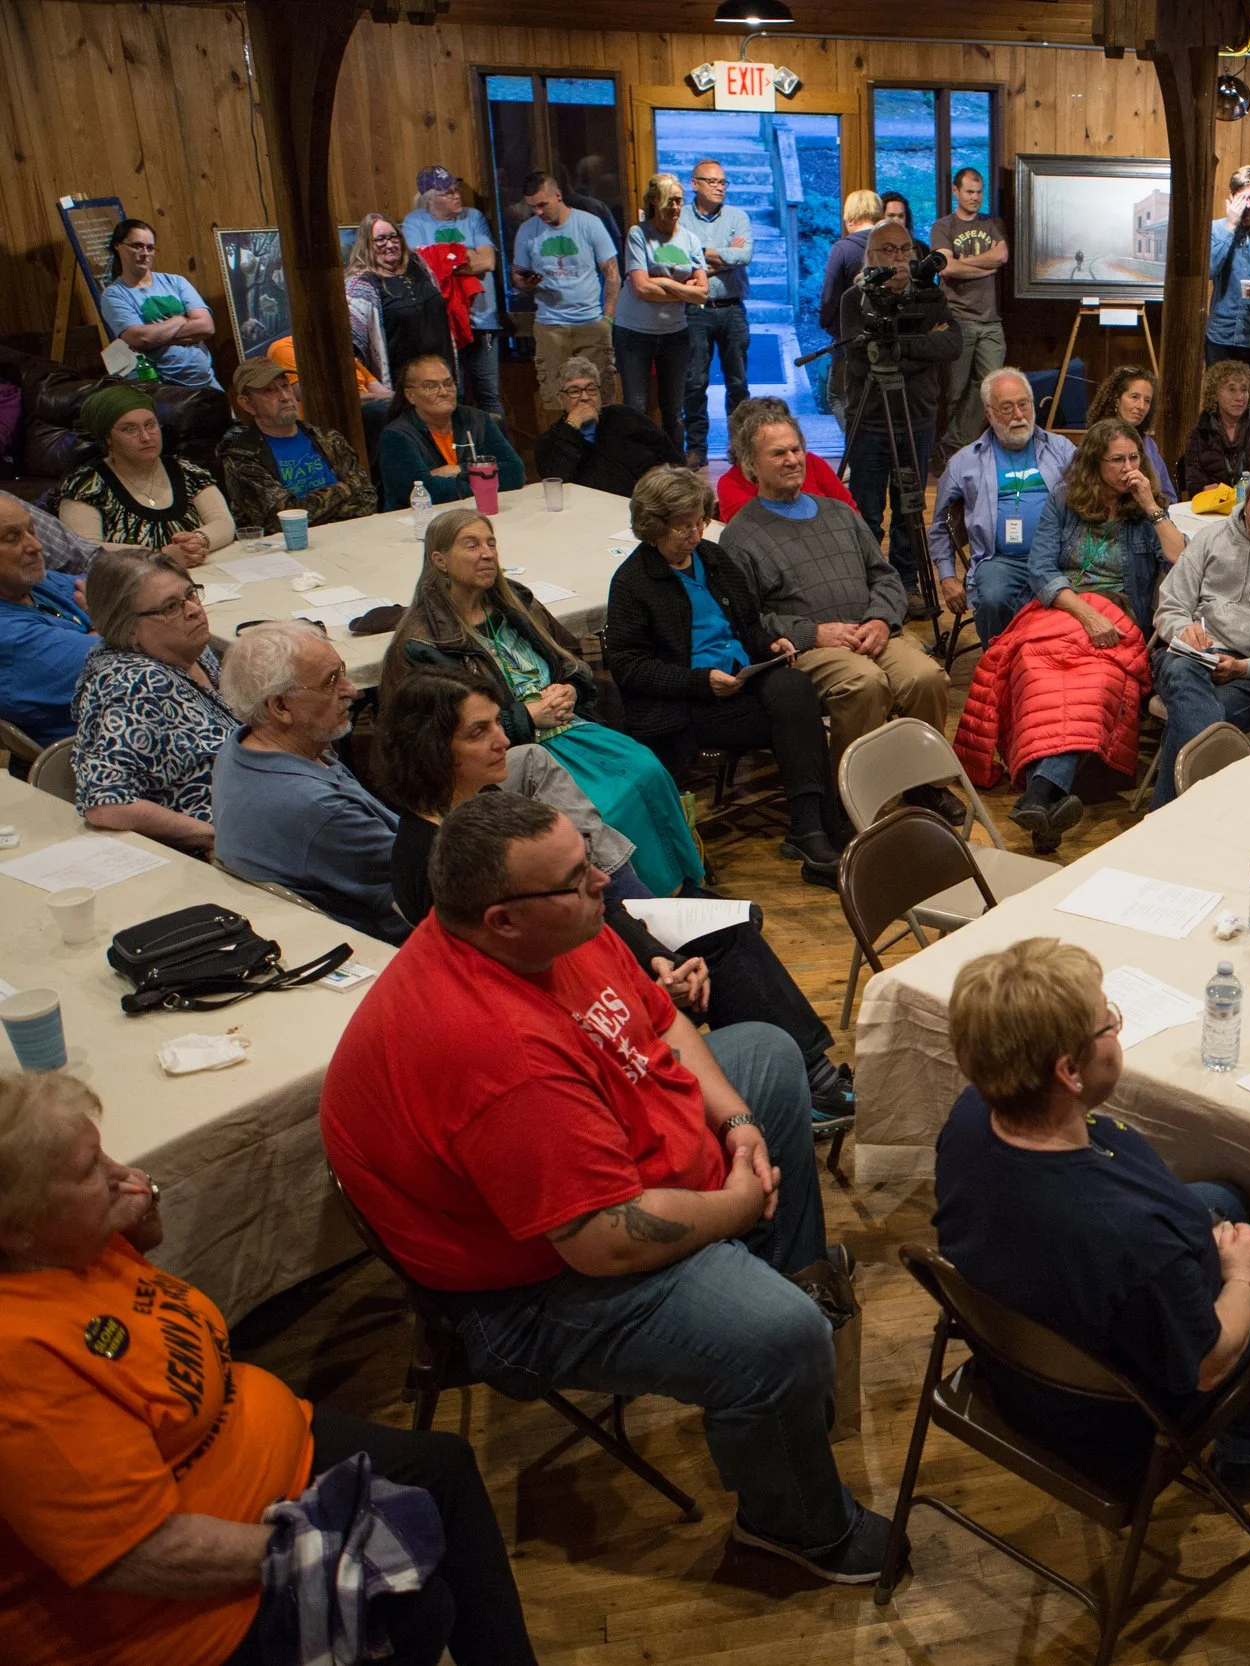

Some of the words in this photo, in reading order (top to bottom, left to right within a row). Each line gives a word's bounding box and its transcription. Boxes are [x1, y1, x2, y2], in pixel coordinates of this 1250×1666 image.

[727, 66, 765, 96] EXIT
[953, 230, 992, 246] DEFEND
[157, 1316, 204, 1416] KENNY
